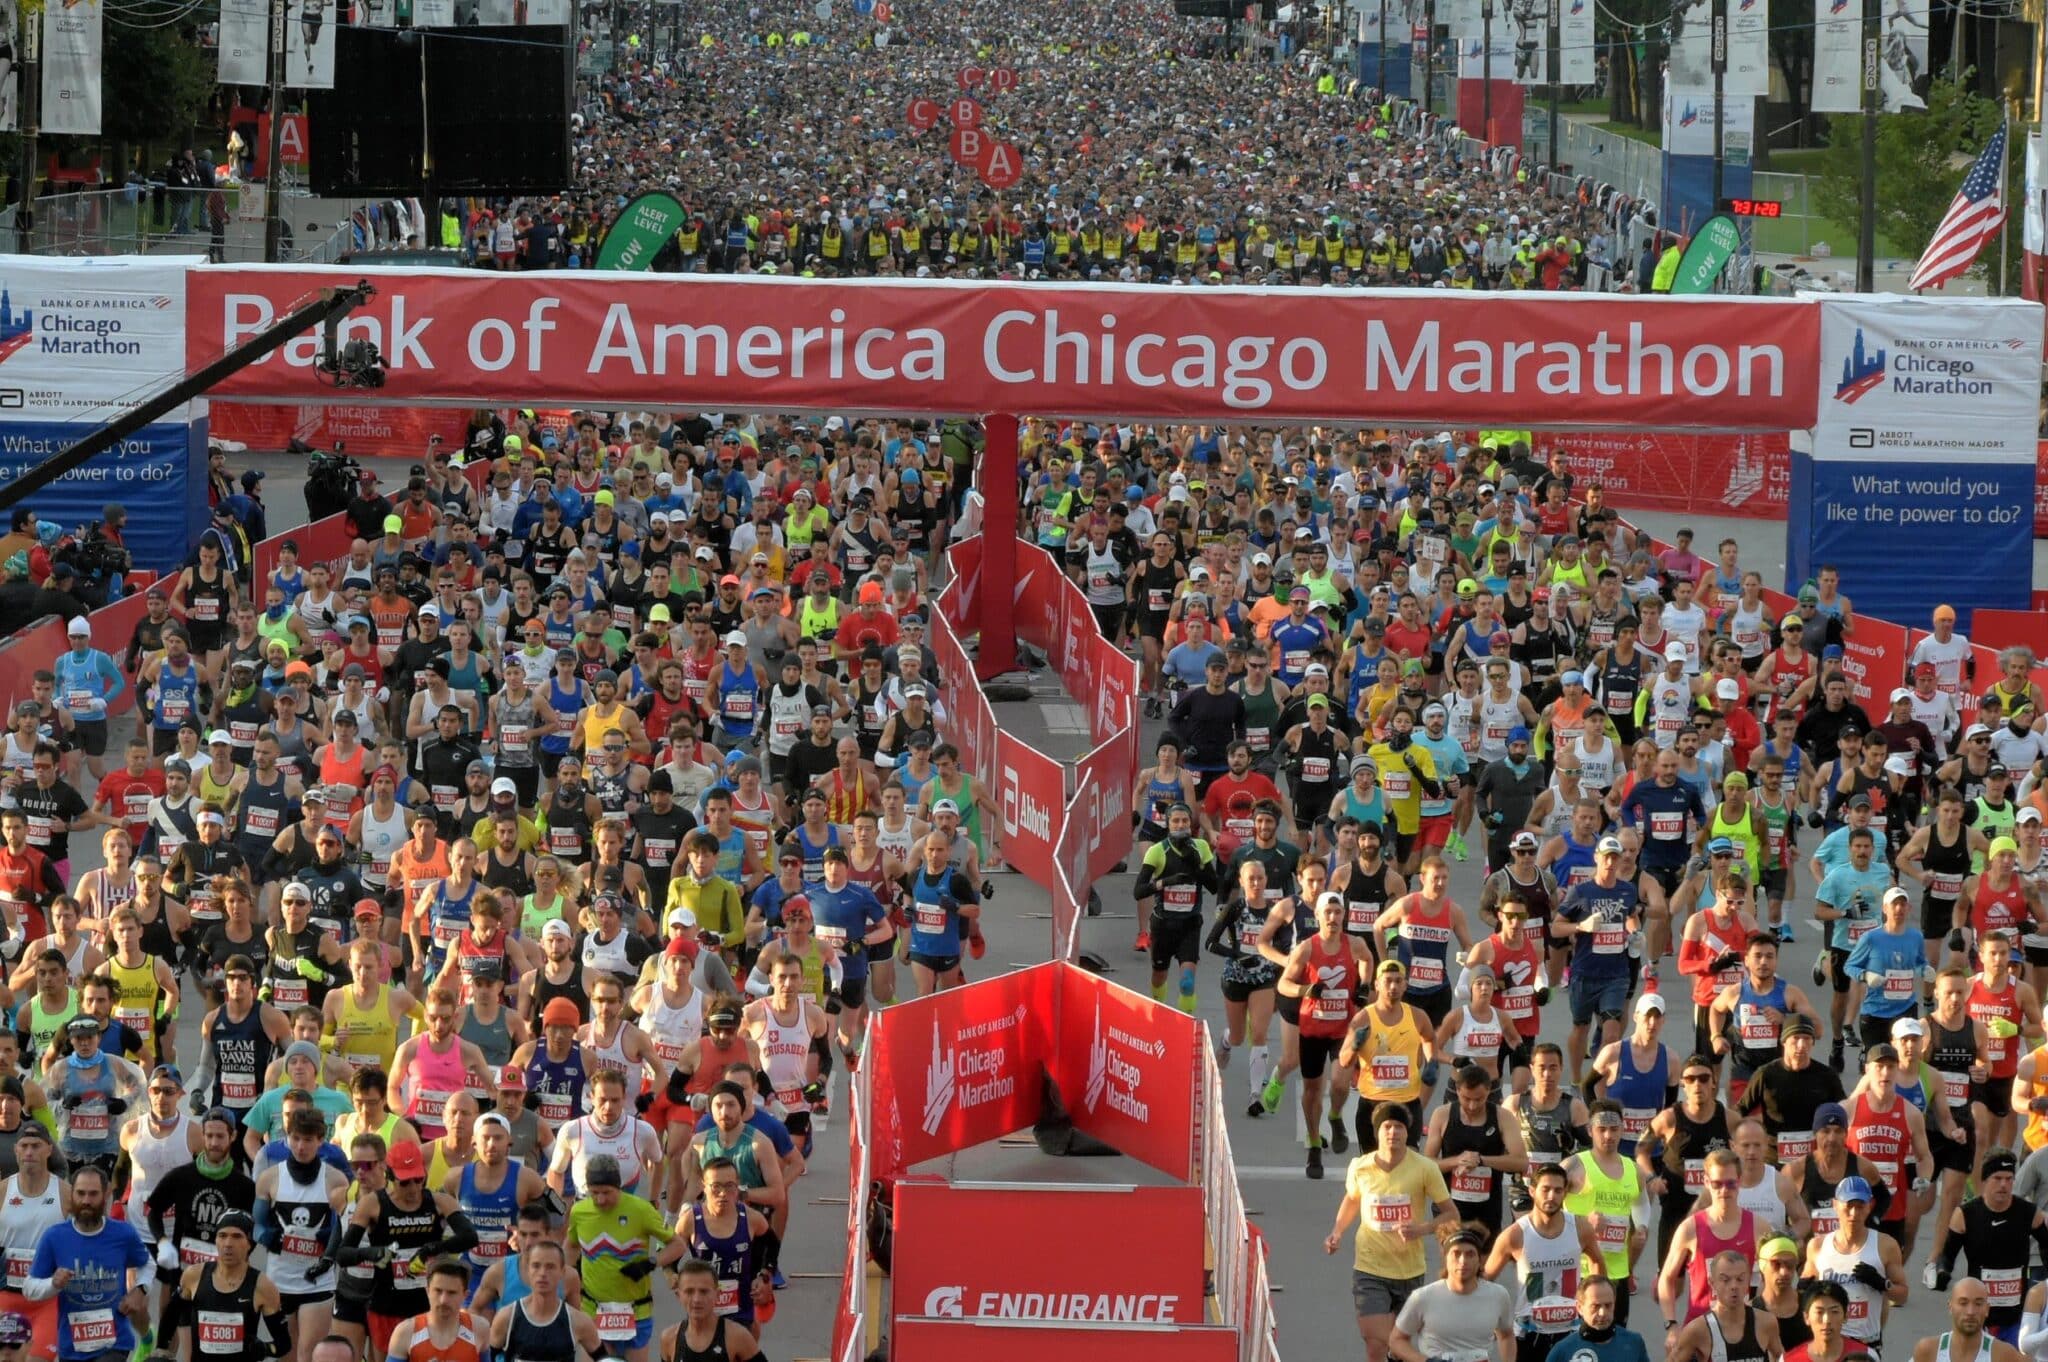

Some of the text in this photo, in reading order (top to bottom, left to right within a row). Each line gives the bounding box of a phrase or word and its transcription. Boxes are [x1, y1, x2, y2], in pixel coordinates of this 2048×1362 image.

[998, 69, 1011, 86] D
[913, 101, 928, 121] C
[958, 101, 973, 121] B
[280, 118, 303, 154] A
[960, 130, 980, 156] B
[987, 144, 1012, 176] A
[638, 204, 669, 222] ALERT
[633, 215, 664, 235] LEVEL
[1712, 221, 1737, 239] ALERT
[1710, 231, 1733, 251] LEVEL
[1693, 252, 1716, 286] LOW
[41, 299, 146, 309] BANK OF AMERICA
[41, 314, 122, 336] Chicago
[41, 336, 141, 355] Marathon
[224, 293, 1785, 408] Bank of America Chicago Marathon
[1894, 339, 2000, 350] BANK OF AMERICA
[1894, 354, 1975, 377] Chicago
[1893, 376, 1993, 395] Marathon
[29, 391, 63, 399] ABBOTT
[328, 422, 392, 438] Marathon
[1879, 431, 1914, 439] ABBOTT
[3, 435, 52, 454] What
[118, 441, 151, 458] you
[1879, 439, 2005, 448] WORLD MARATHON MAJORS
[115, 466, 136, 481] to
[140, 463, 174, 482] do?
[1852, 475, 2000, 501] What would you
[1826, 503, 2021, 527] like the power to do?
[22, 797, 58, 812] RUNNER
[1020, 791, 1051, 843] Abbott
[1655, 823, 1679, 832] A 1107
[1407, 925, 1449, 942] CATHOLIC
[1411, 967, 1418, 977] A
[957, 1016, 1016, 1041] BANK OF AMERICA
[1745, 1026, 1751, 1037] A
[217, 1040, 255, 1052] TEAM
[1108, 1025, 1154, 1056] BANK OF AMERICA
[220, 1052, 255, 1065] PAWS
[958, 1047, 1005, 1077] Chicago
[221, 1063, 256, 1073] CHICAGO
[1107, 1049, 1141, 1091] Chicago
[1377, 1067, 1383, 1078] A
[958, 1076, 1014, 1110] Marathon
[1106, 1082, 1148, 1124] Marathon
[74, 1117, 81, 1128] A
[1855, 1125, 1905, 1142] GREATER
[1784, 1146, 1791, 1157] A
[1859, 1141, 1899, 1155] BOSTON
[1455, 1179, 1462, 1190] A
[1687, 1172, 1695, 1185] A
[1816, 1222, 1824, 1232] A
[287, 1239, 295, 1250] A
[9, 1261, 18, 1274] A
[1529, 1257, 1575, 1269] SANTIAGO
[976, 1292, 1179, 1324] ENDURANCE
[1535, 1311, 1544, 1321] A
[599, 1315, 607, 1328] A
[74, 1323, 113, 1340] A 15072
[203, 1326, 237, 1340] A 5081
